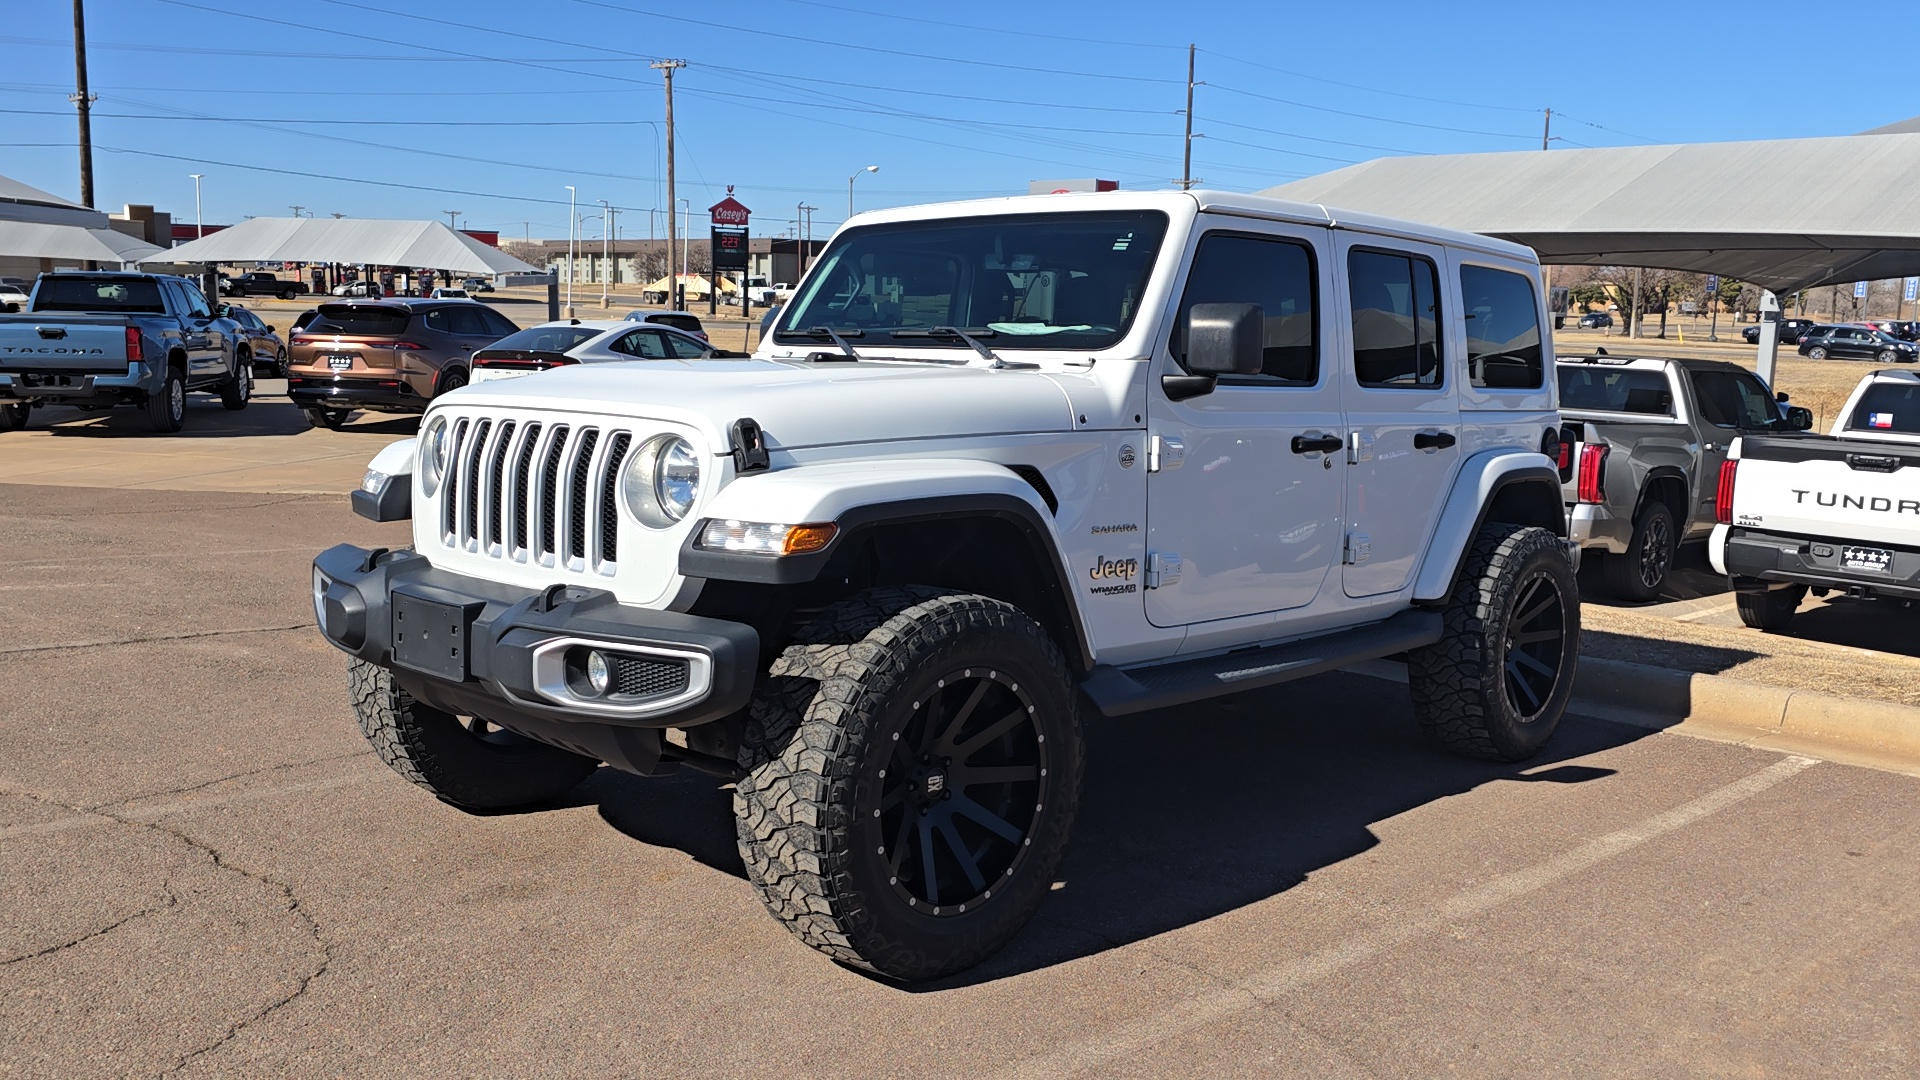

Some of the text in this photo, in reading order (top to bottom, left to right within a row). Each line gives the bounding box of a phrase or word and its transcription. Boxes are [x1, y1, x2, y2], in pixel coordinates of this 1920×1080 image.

[716, 207, 747, 222] Casey's
[3, 346, 104, 355] TACOMA
[1791, 489, 1920, 515] TUNDR
[1091, 523, 1138, 535] SAHARA
[1090, 555, 1138, 581] Jeep
[1846, 559, 1864, 567] AUTO
[1864, 561, 1886, 569] GROUP
[1090, 583, 1136, 594] WRANGLER
